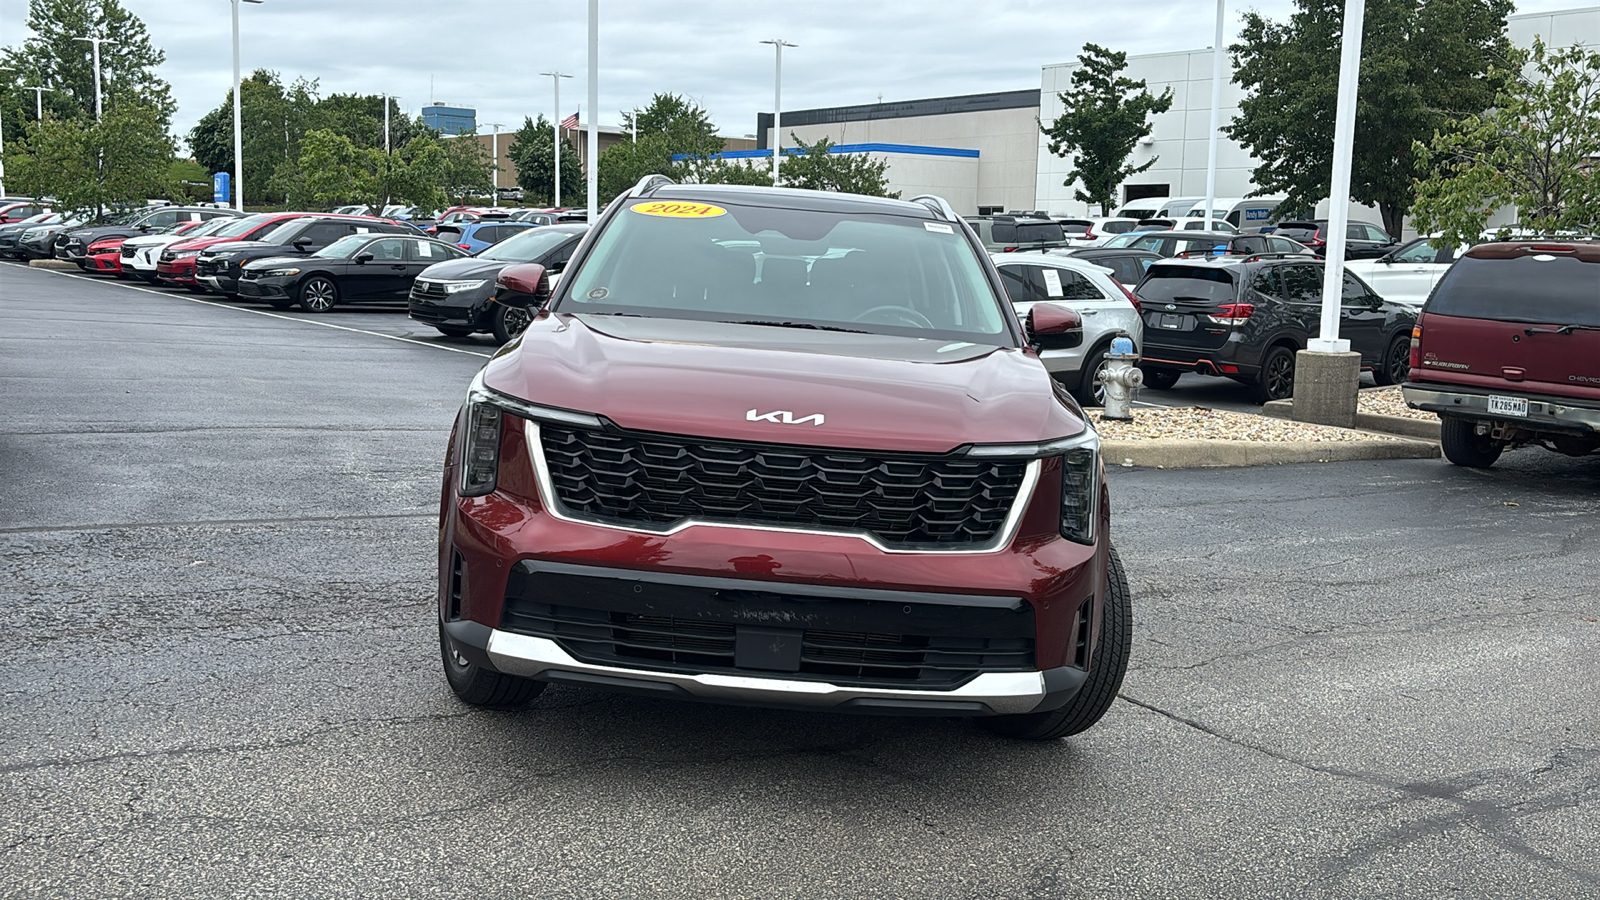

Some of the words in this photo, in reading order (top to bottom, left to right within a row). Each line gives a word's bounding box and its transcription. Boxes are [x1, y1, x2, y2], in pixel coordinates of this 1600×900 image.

[646, 203, 712, 215] 2024
[1246, 210, 1257, 220] Andy
[1431, 361, 1470, 369] SUBURBAN
